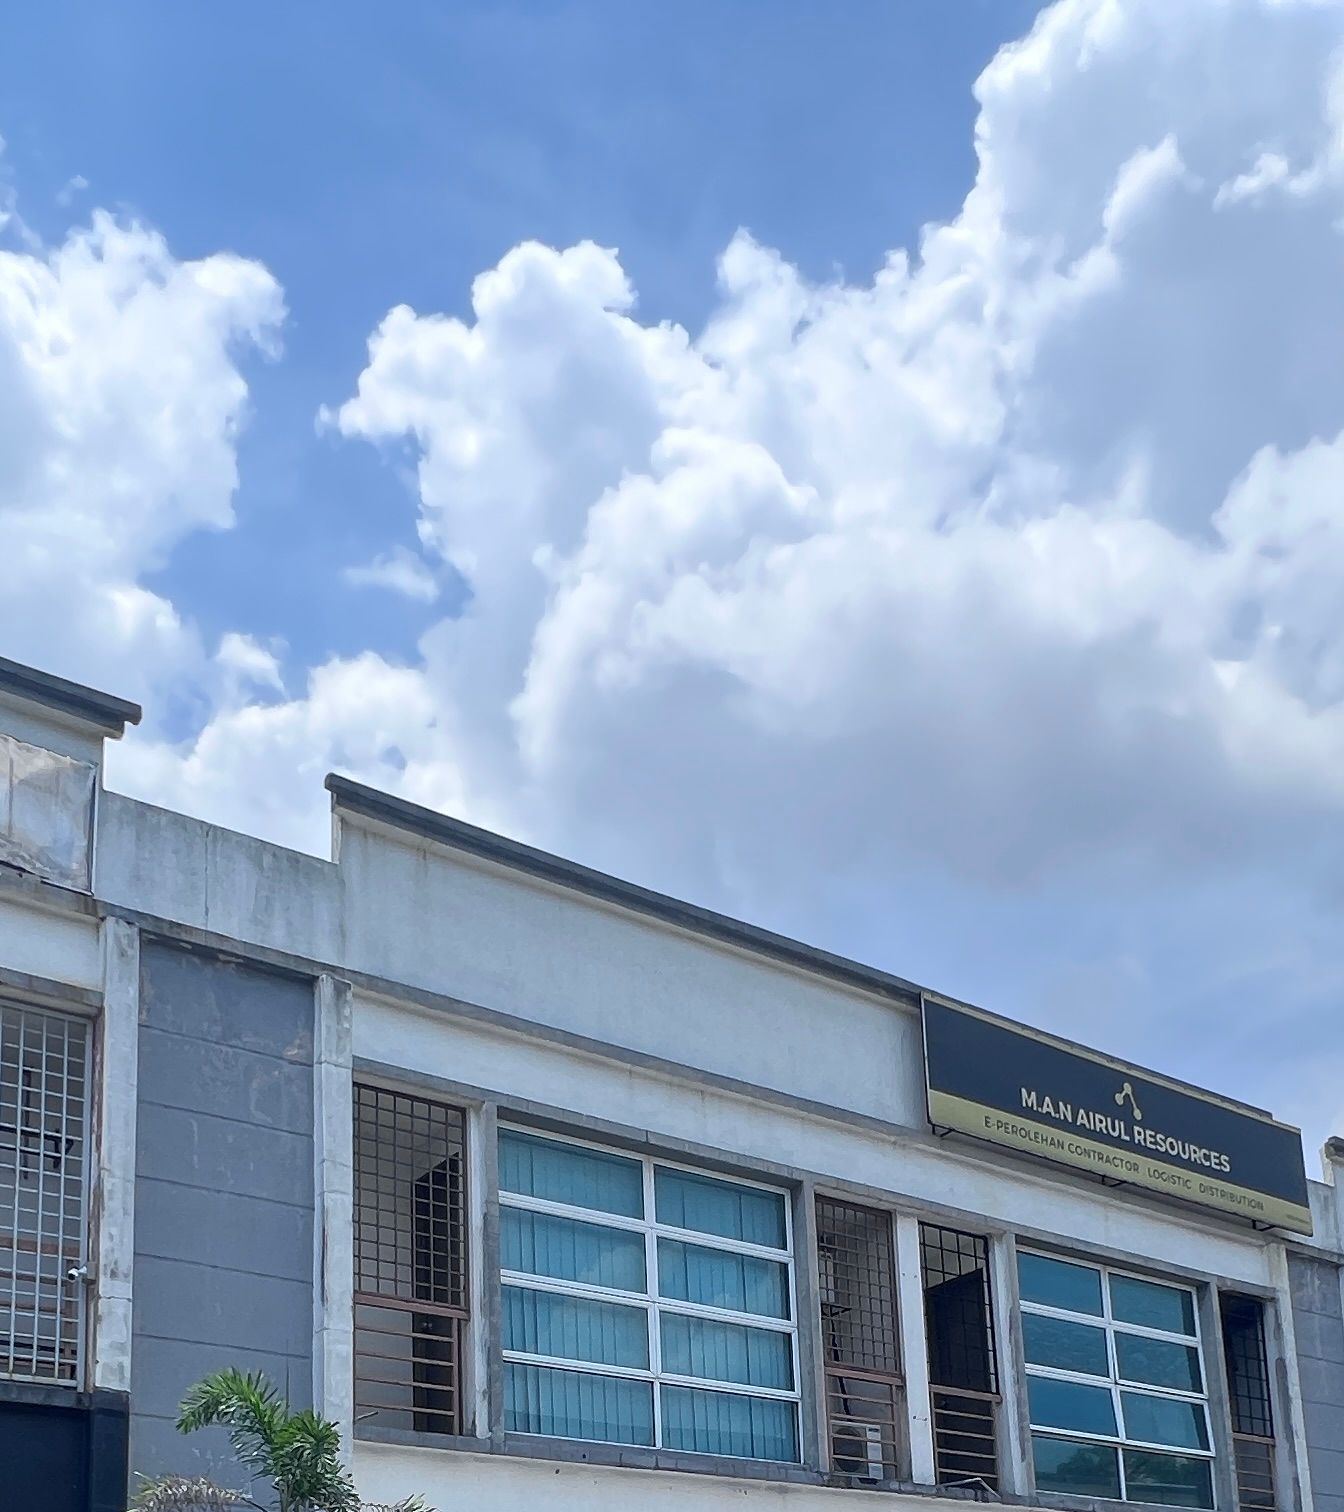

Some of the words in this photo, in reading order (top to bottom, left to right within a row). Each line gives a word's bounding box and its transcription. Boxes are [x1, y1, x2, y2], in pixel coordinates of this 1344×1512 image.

[984, 1115, 1065, 1150] E-PEROLEHAN
[1067, 1142, 1140, 1173] CONTRACTOR
[1147, 1167, 1192, 1190] LOGISTIC
[1199, 1183, 1265, 1211] DISTRIBUTION
[1020, 1087, 1073, 1123] M.A.N
[1076, 1108, 1131, 1142] AIRUL
[1133, 1125, 1231, 1172] RESOURCES
